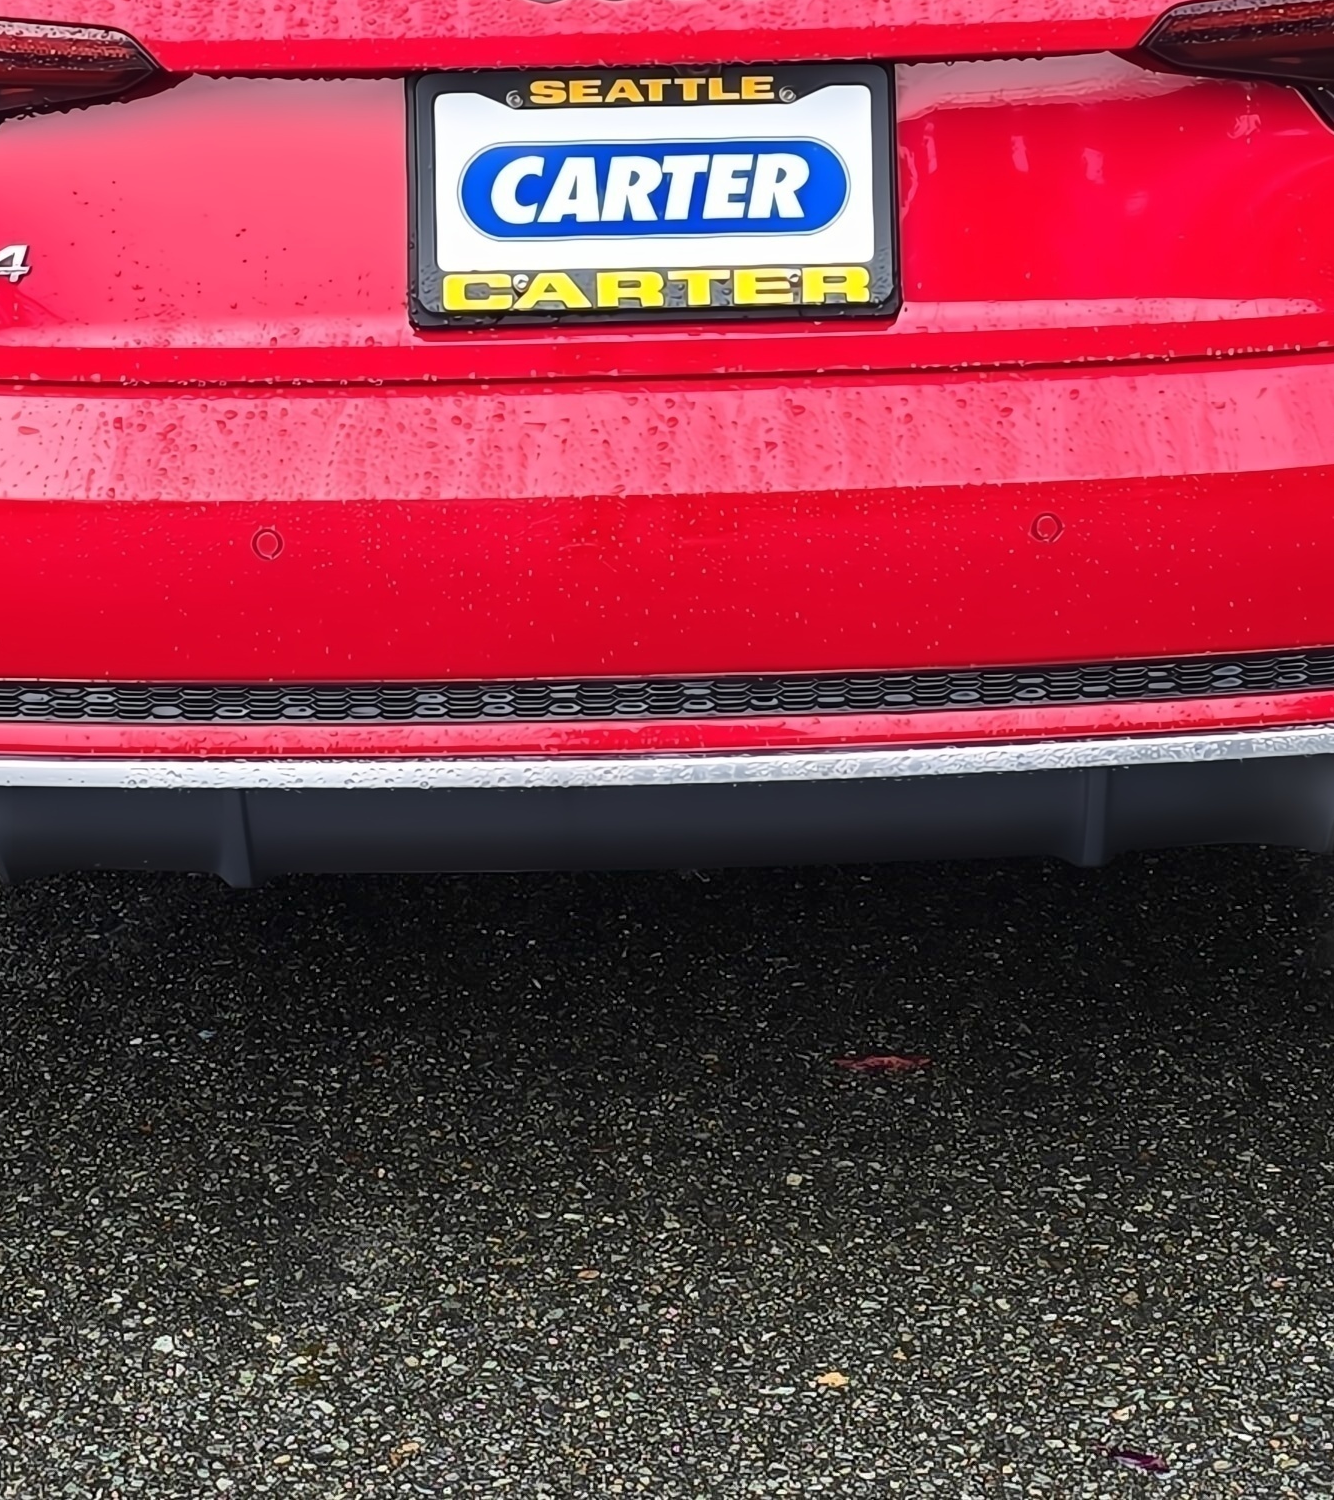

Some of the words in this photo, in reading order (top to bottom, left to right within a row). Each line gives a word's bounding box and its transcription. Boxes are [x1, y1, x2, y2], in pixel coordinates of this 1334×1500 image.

[529, 75, 775, 104] SEATTLE
[490, 152, 810, 224] CARTER
[441, 266, 871, 312] CARTER
